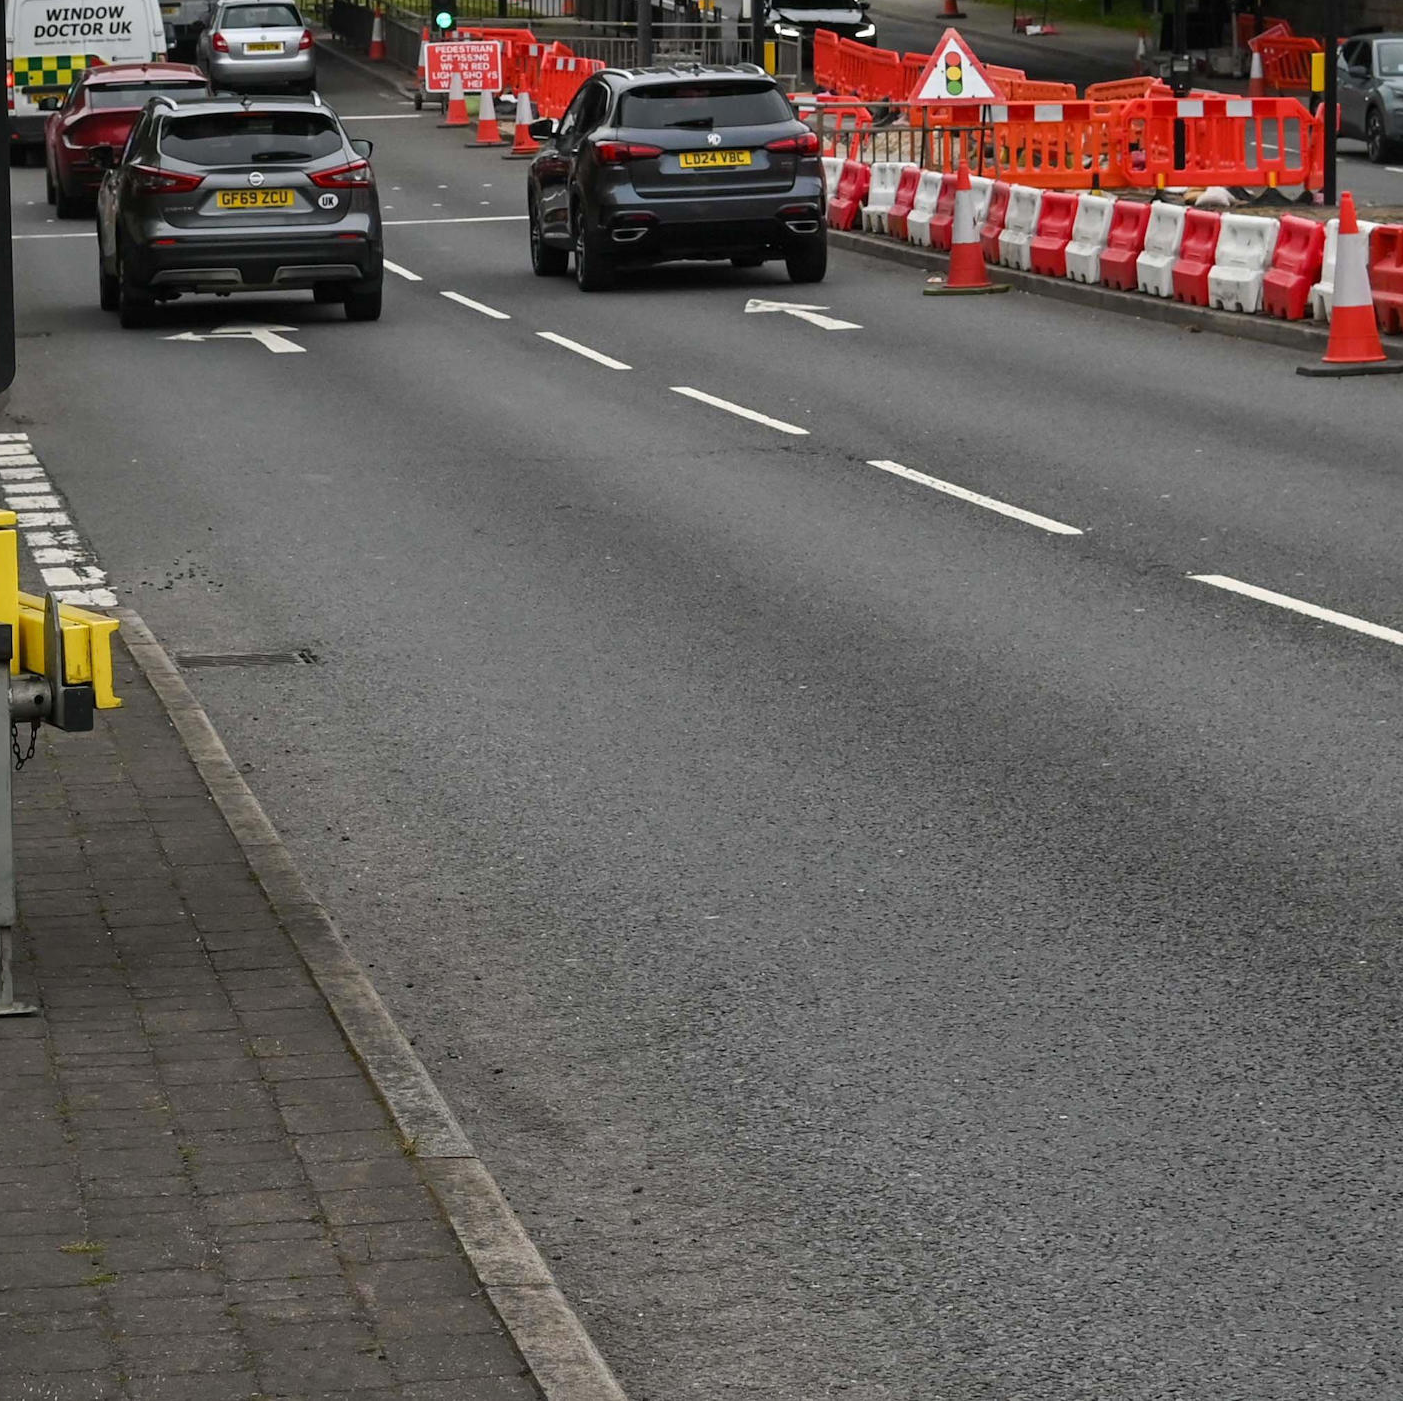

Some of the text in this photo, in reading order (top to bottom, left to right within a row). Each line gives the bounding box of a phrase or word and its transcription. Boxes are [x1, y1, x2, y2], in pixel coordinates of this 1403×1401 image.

[46, 6, 125, 22] WINDOW
[34, 21, 132, 38] DOCTOR UK
[435, 45, 493, 53] PEDESTRIAN
[440, 62, 490, 71] WHN RED
[462, 71, 499, 79] SHOS
[721, 151, 745, 163] VBC
[222, 191, 288, 205] GF69 ZCU
[322, 196, 334, 207] UK
